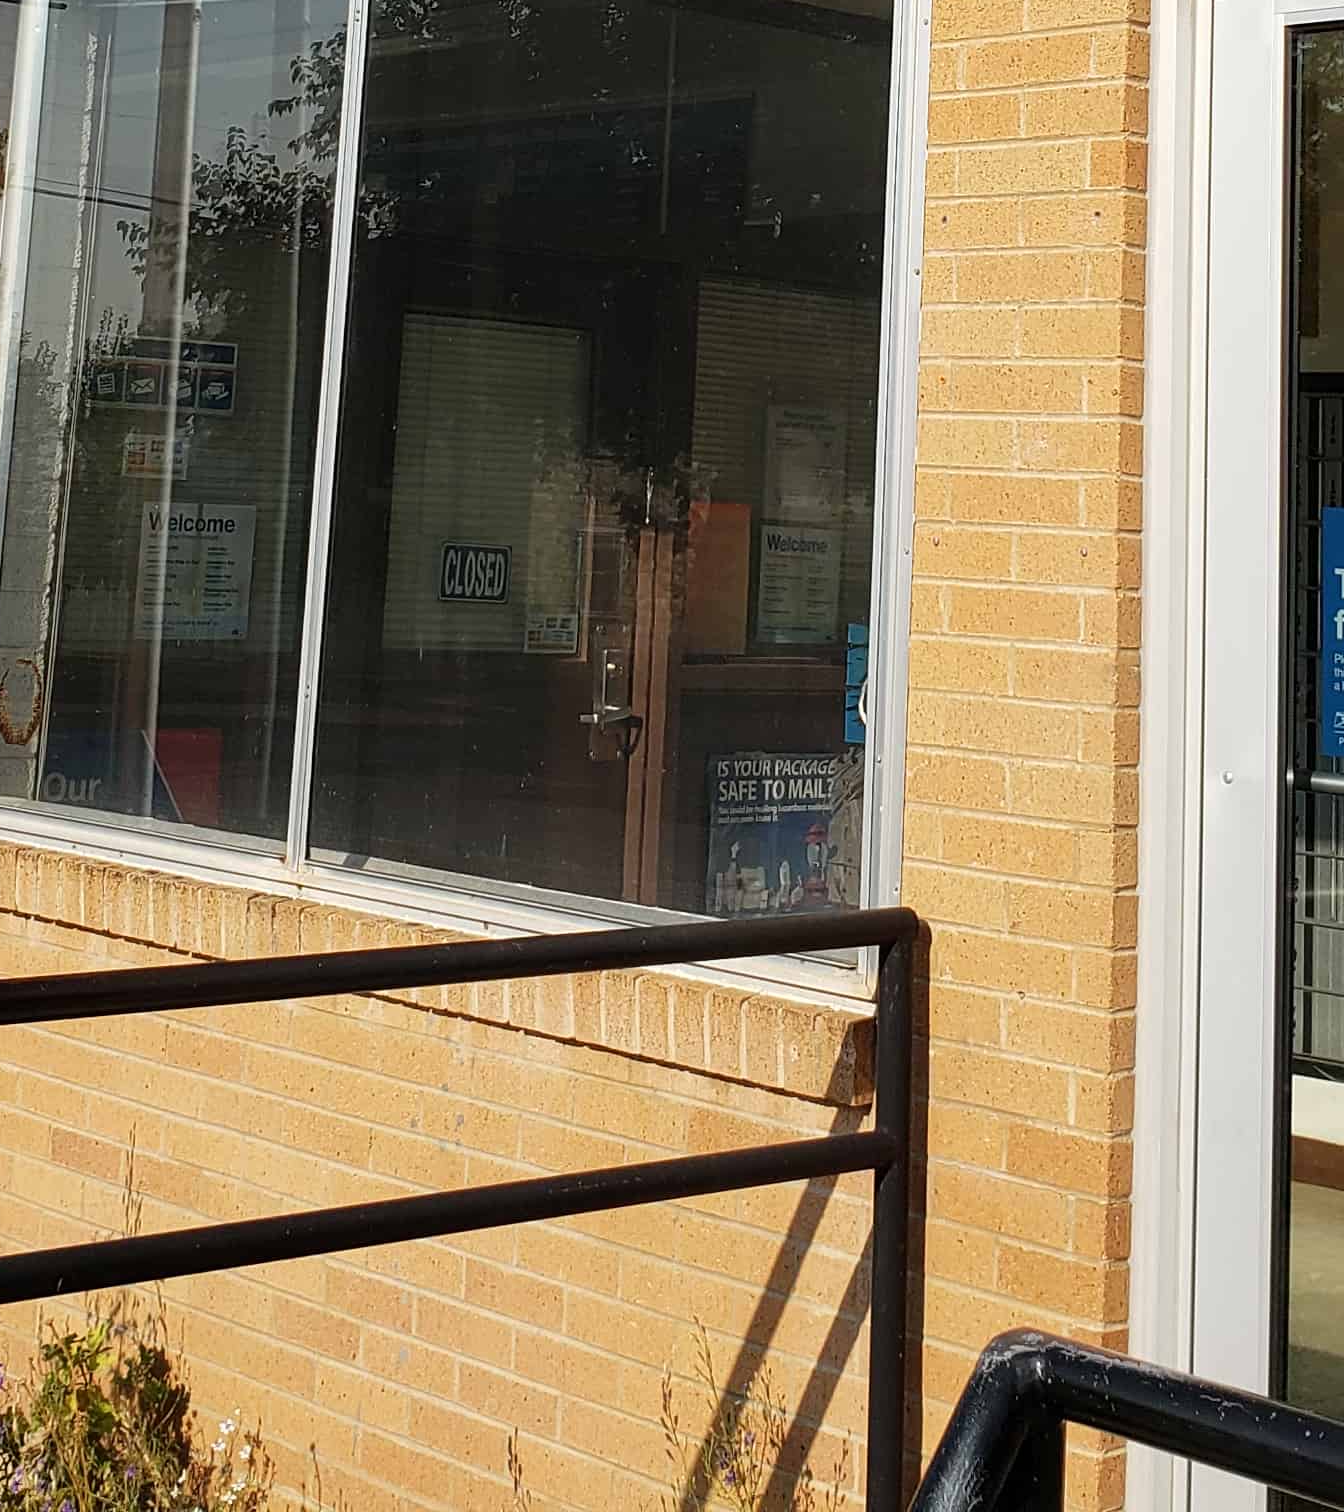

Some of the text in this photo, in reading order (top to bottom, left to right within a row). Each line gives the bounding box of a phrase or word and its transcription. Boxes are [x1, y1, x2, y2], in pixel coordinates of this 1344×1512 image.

[148, 510, 236, 534] Welcome
[766, 533, 829, 554] Welcome
[445, 549, 505, 597] CLOSED
[717, 760, 729, 778] IS
[734, 760, 772, 777] YOUR
[47, 772, 102, 802] Our
[718, 777, 834, 802] SAFE TO MAIL?
